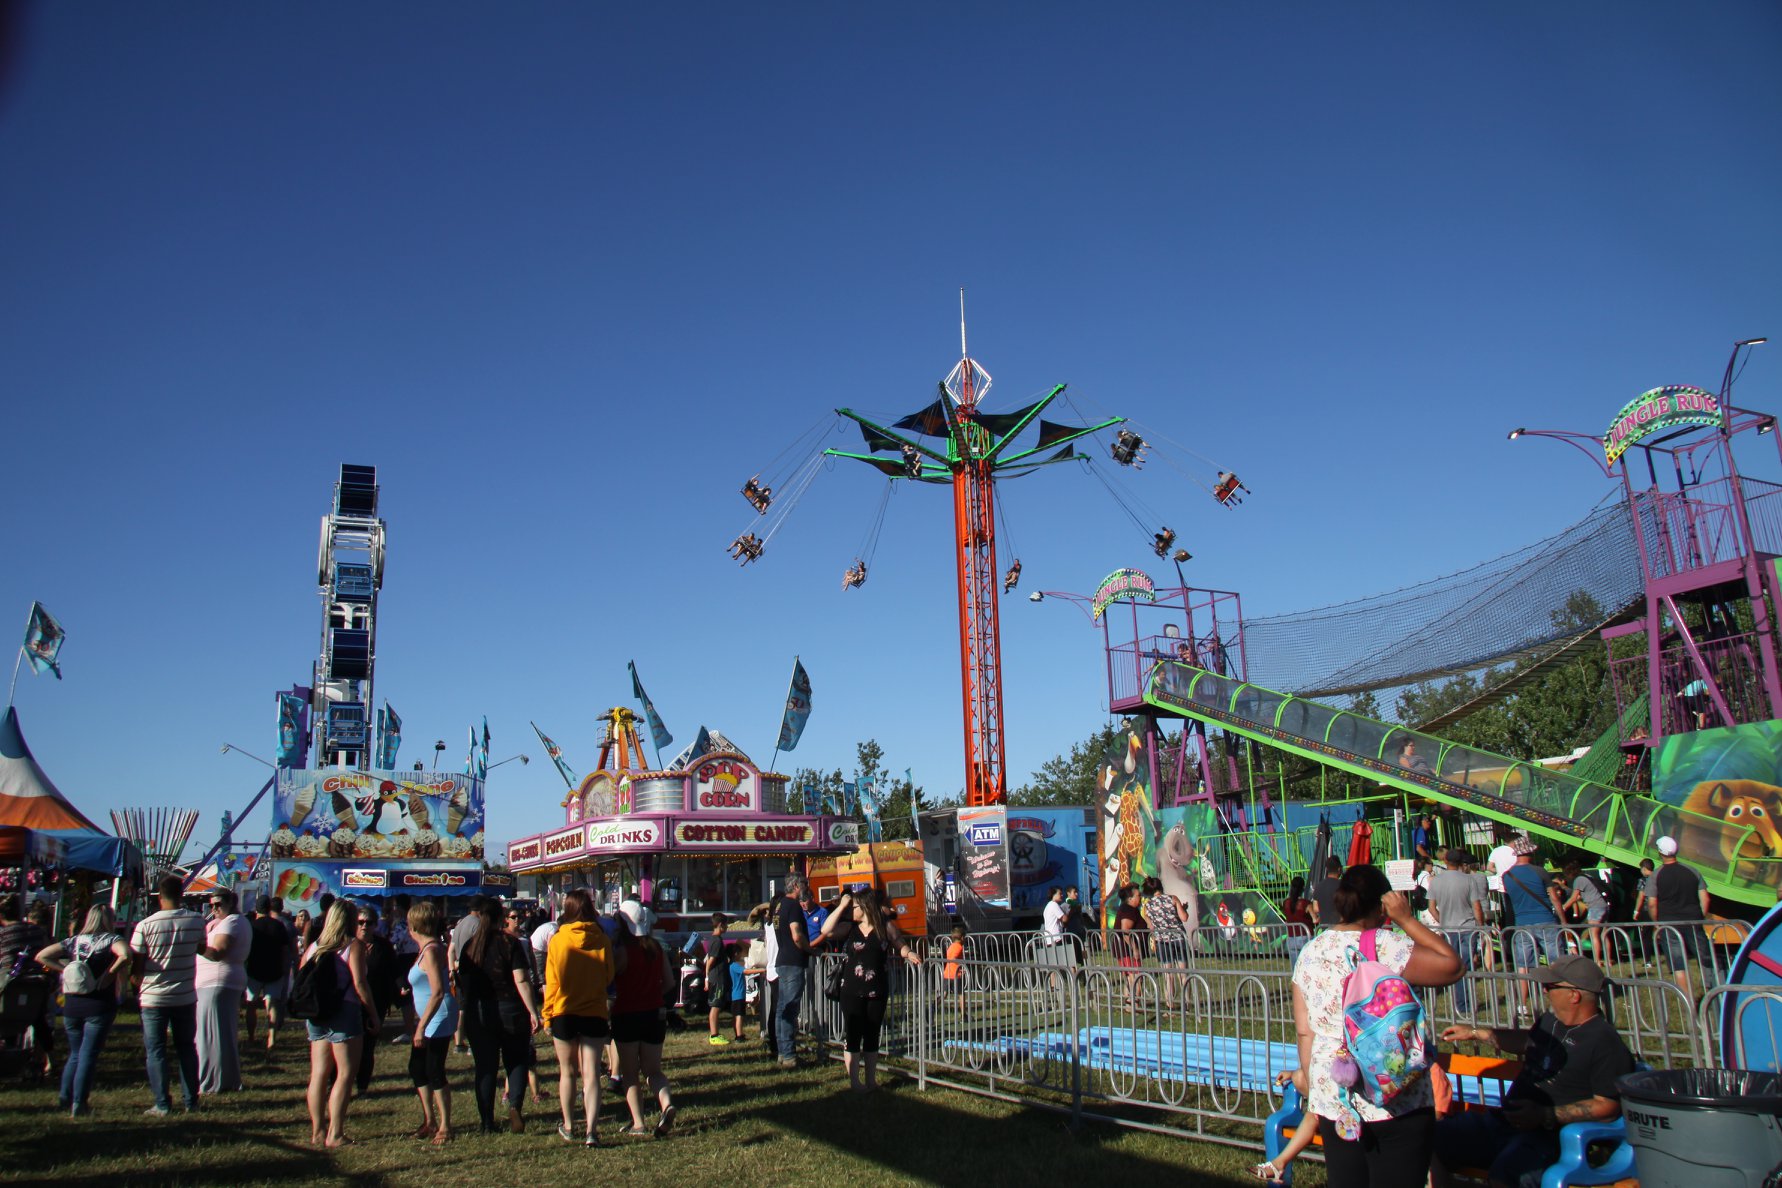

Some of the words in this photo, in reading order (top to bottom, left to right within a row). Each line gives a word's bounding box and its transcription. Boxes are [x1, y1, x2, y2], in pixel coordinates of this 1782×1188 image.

[1609, 396, 1671, 450] JUNGLE
[1676, 393, 1718, 412] RUN
[1095, 575, 1128, 607] JUNGLE
[1131, 575, 1152, 592] RUN
[699, 761, 749, 784] POP
[322, 774, 370, 793] Chill
[400, 780, 455, 796] Zone
[700, 792, 750, 807] CORN
[589, 822, 621, 842] Cold
[600, 829, 652, 845] DRINKS
[682, 824, 747, 841] COTTON
[754, 825, 808, 841] CANDY
[974, 828, 999, 840] ATM
[545, 831, 583, 855] POPCORN
[1627, 1109, 1673, 1130] BRUTE
